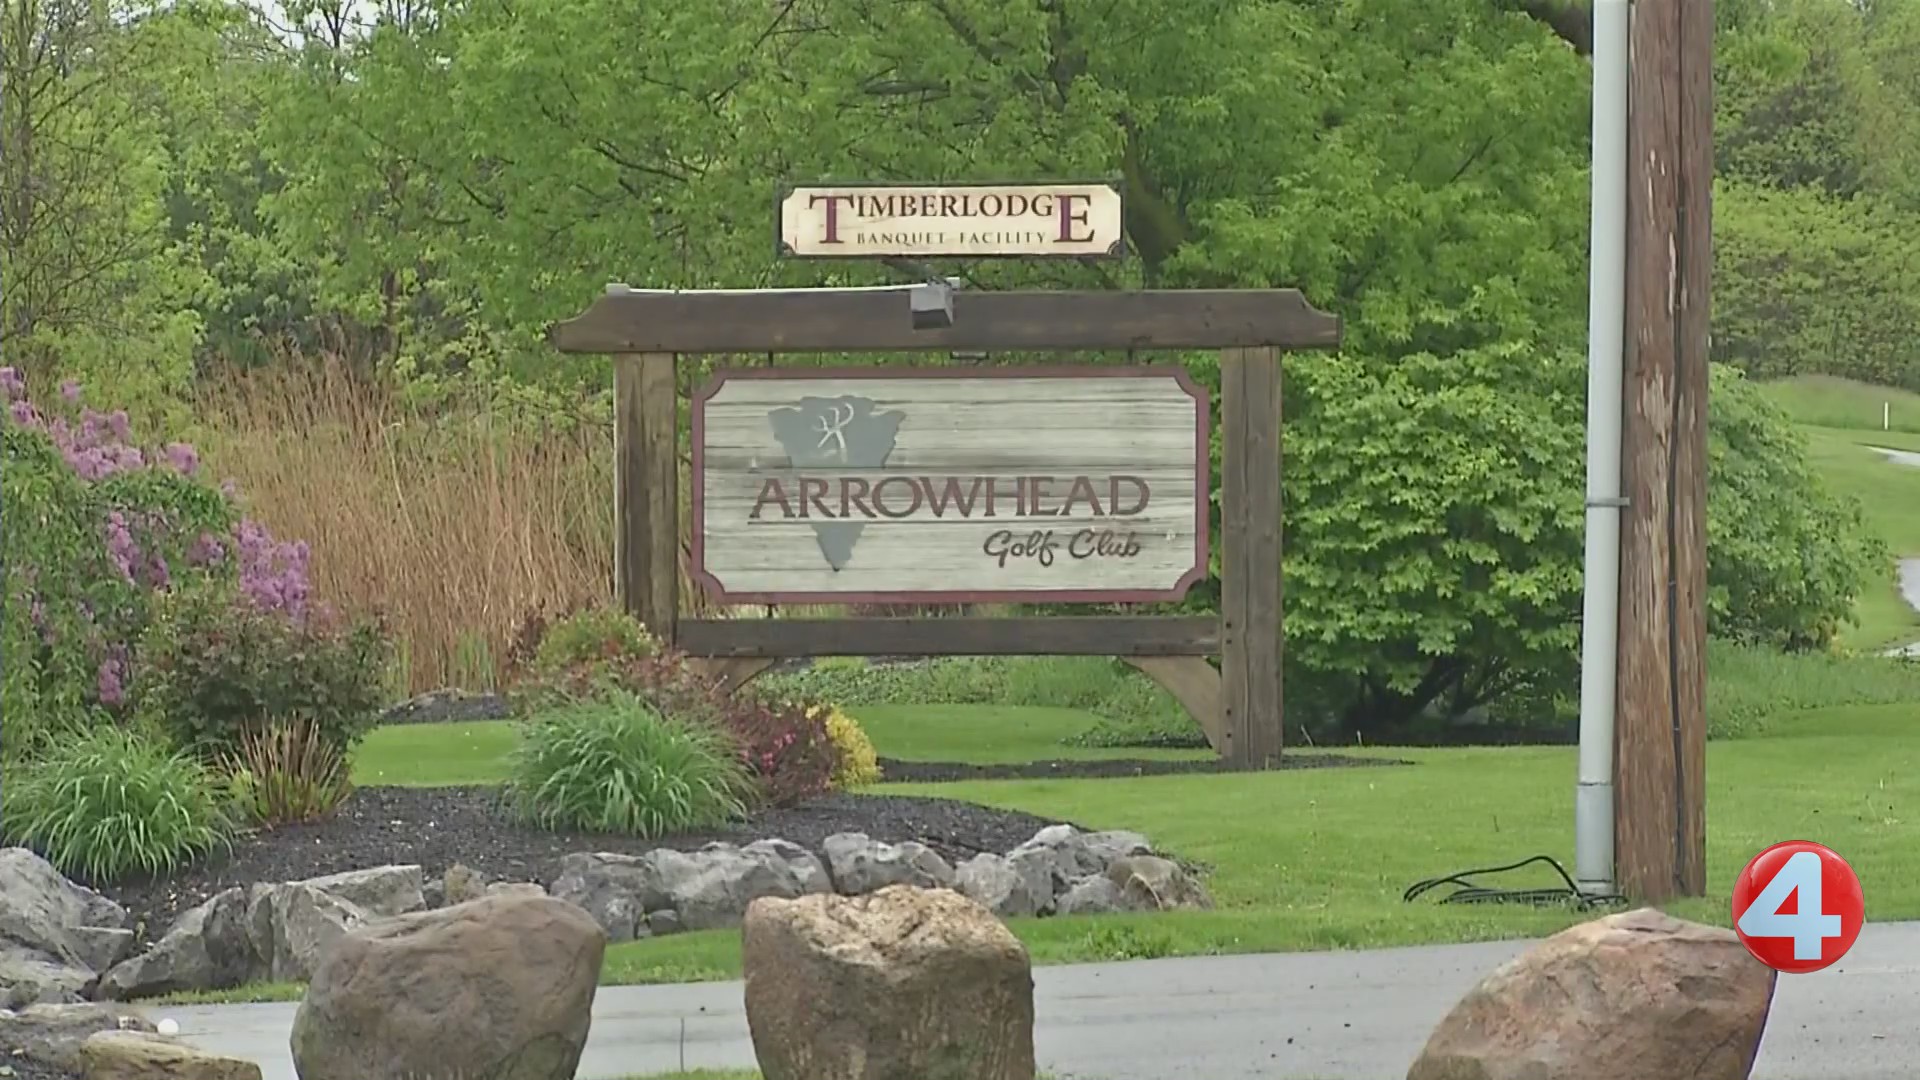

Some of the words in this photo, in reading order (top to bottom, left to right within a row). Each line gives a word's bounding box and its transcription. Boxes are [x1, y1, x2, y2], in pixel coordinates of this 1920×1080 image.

[809, 193, 1096, 245] TIMBERLODGE
[857, 231, 946, 246] BANQUET
[959, 231, 1047, 245] FACILITY
[748, 475, 1151, 519] ARROWHEAD
[983, 529, 1057, 568] Golf
[1068, 529, 1142, 560] Club
